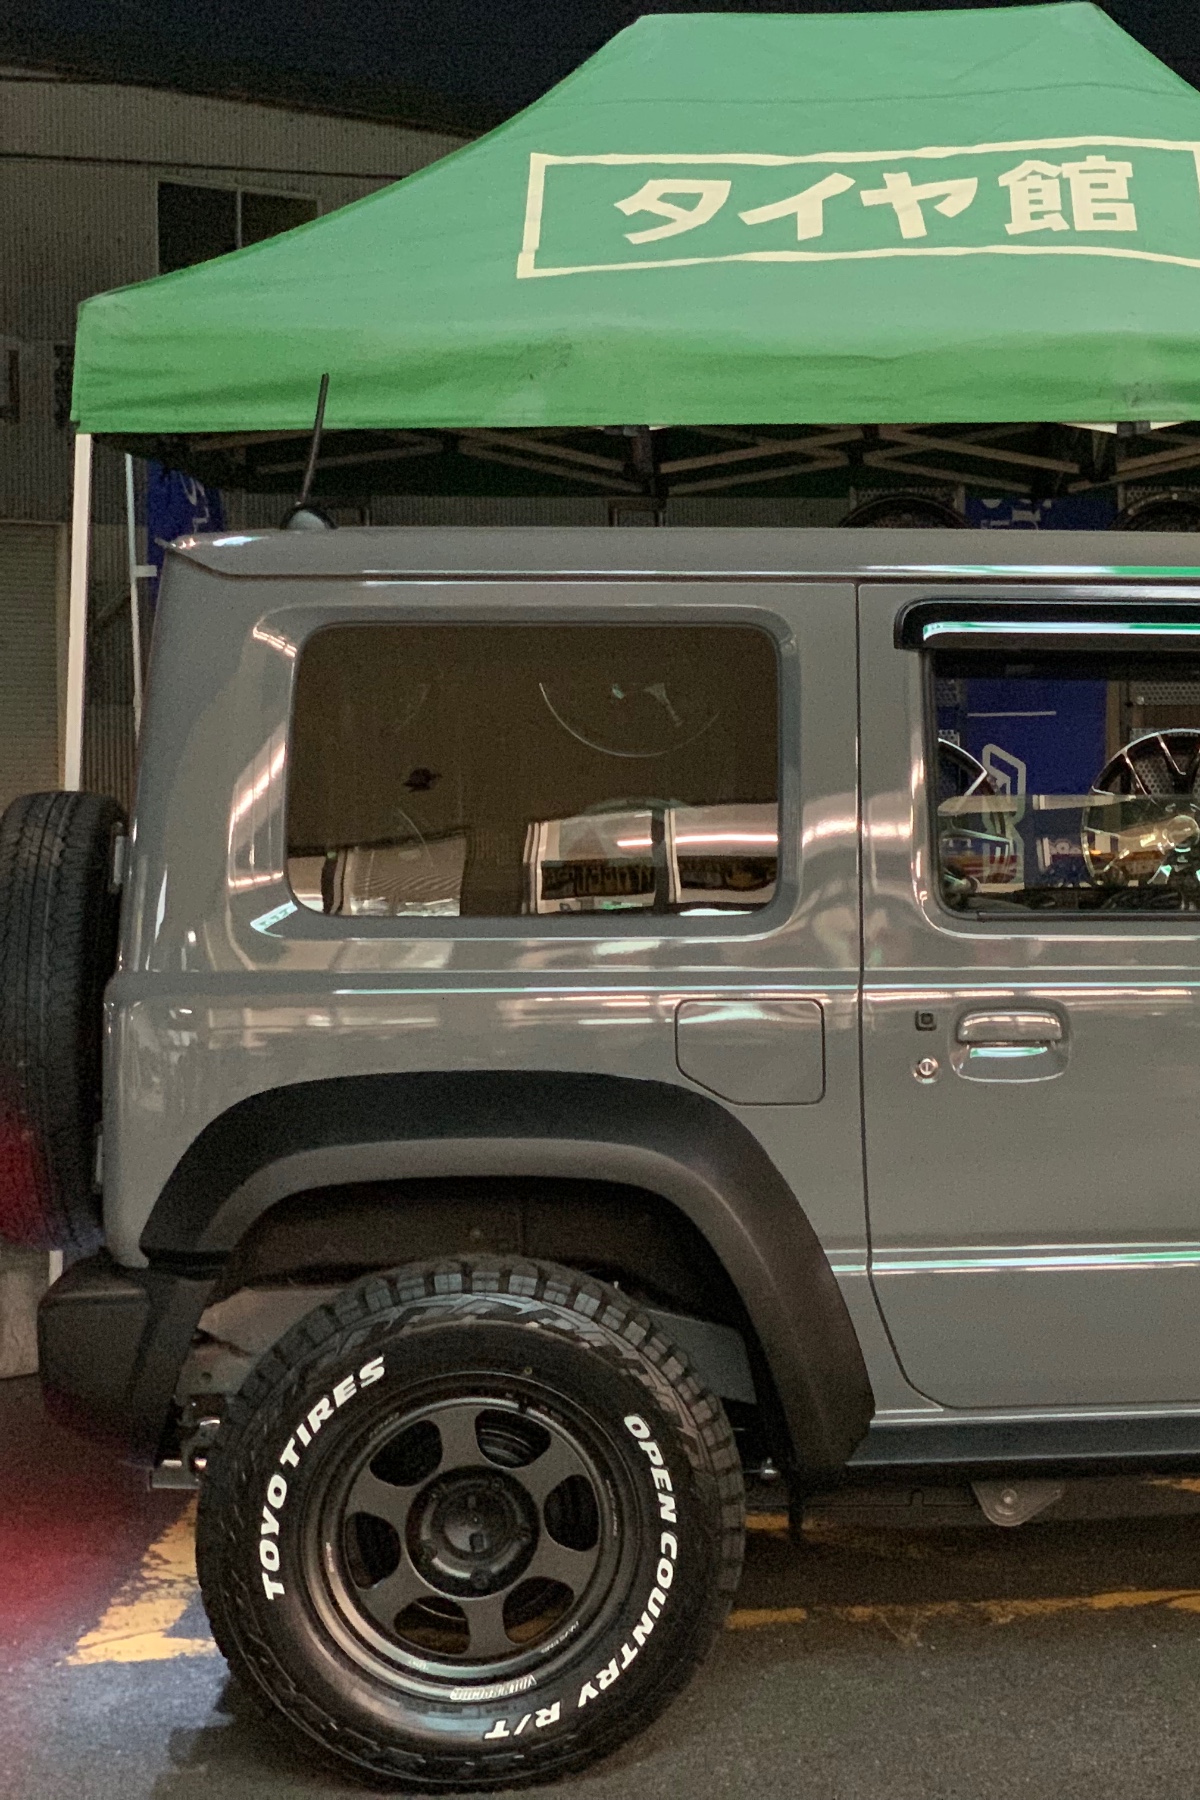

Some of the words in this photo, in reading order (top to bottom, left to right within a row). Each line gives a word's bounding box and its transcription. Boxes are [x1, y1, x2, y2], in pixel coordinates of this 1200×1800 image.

[613, 155, 1138, 245] タイヤ館
[258, 1474, 288, 1601] TOYO
[280, 1356, 386, 1468] TIRES
[623, 1415, 678, 1523] OPEN
[577, 1531, 678, 1709] COUNTRY
[484, 1700, 562, 1740] R/T
